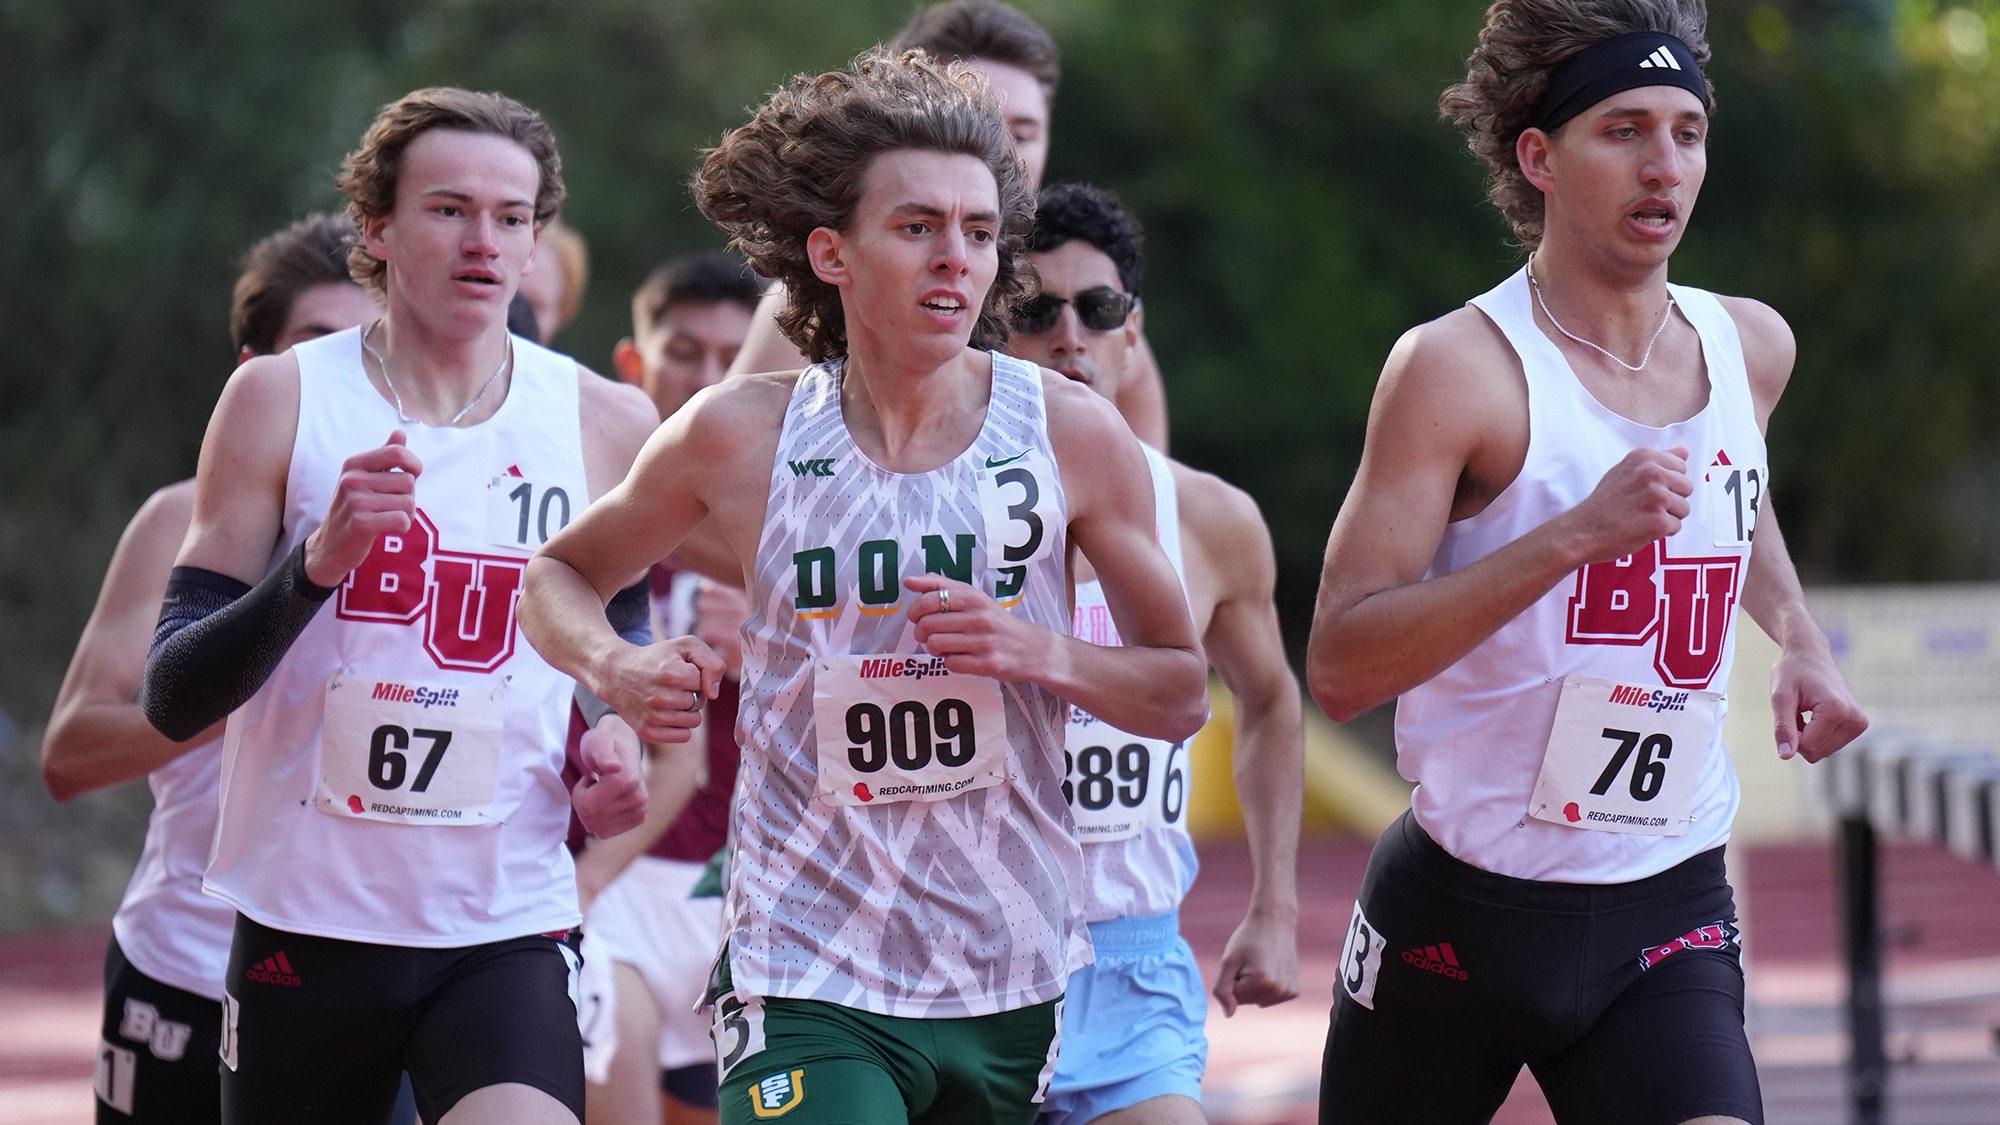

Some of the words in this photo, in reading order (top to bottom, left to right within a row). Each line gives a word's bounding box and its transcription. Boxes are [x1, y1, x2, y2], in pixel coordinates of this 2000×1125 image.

[788, 458, 836, 477] WCC
[508, 482, 570, 545] 10
[995, 467, 1043, 562] 3
[1724, 469, 1760, 542] 13
[336, 507, 530, 674] BU
[1565, 537, 1742, 689] BU
[371, 682, 459, 708] MileSplit
[1608, 685, 1689, 713] MileSplit
[368, 724, 453, 793] 67
[845, 698, 976, 773] 909
[1589, 727, 1673, 802] 76
[371, 803, 462, 819] REDCAPTIMING.COM
[879, 777, 975, 796] REDCAPTIMING.COM
[1161, 743, 1184, 824] 6
[1077, 822, 1131, 835] TIMING.COM
[1587, 811, 1669, 826] REDCAPTIMING.COM
[246, 970, 302, 986] adidas
[1344, 913, 1371, 994] 13
[1402, 951, 1469, 981] adidas
[118, 997, 192, 1062] BU
